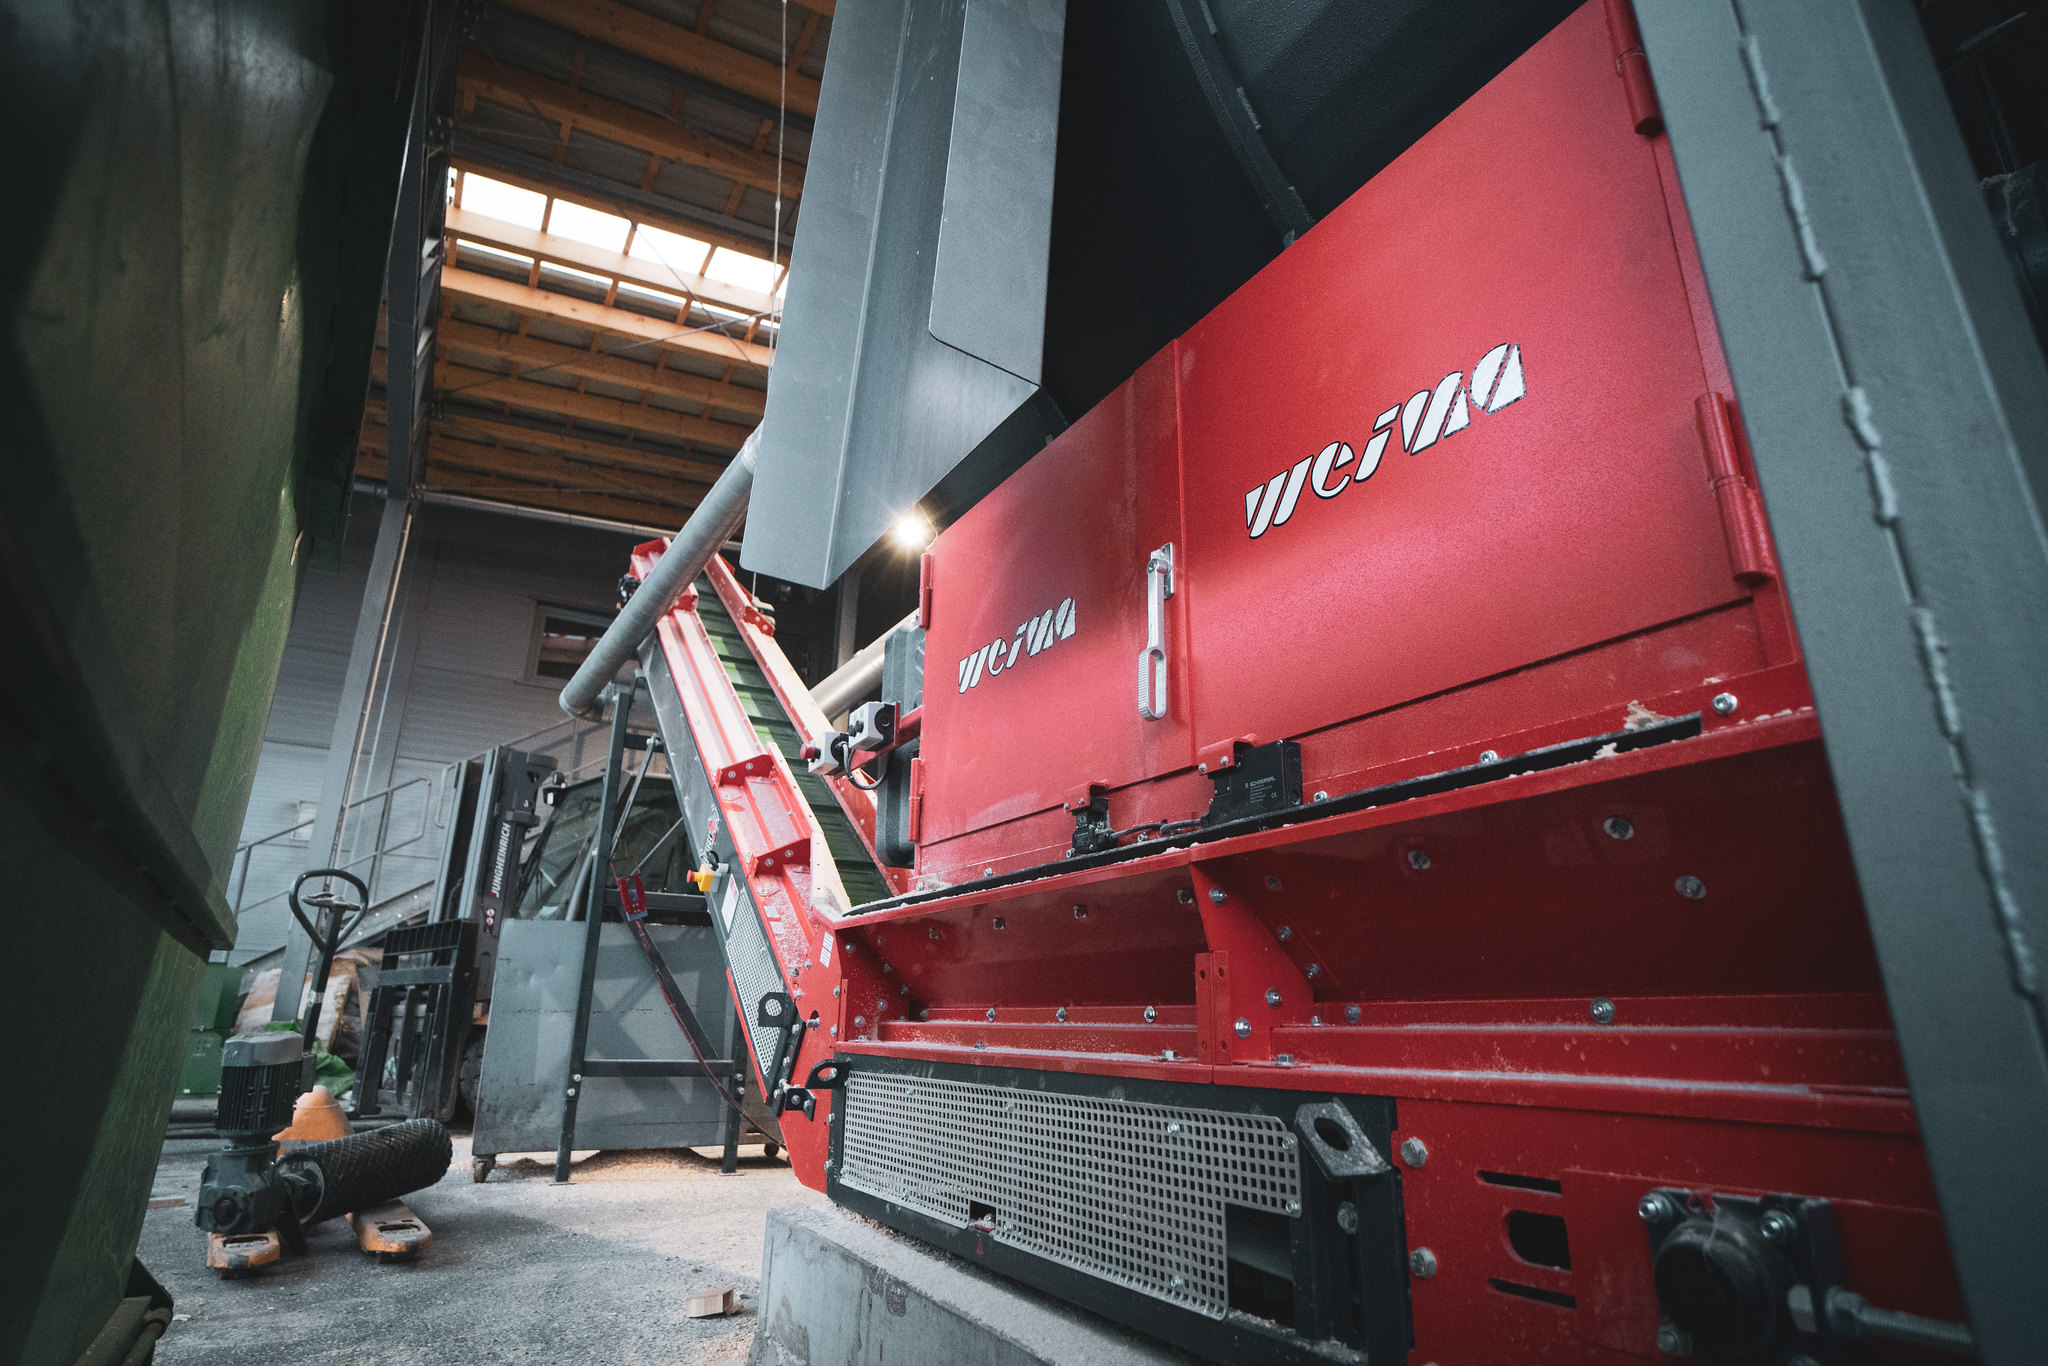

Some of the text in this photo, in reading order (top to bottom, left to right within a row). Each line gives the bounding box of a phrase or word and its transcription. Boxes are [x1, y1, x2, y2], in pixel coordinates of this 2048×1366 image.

[1244, 342, 1527, 540] weima
[958, 596, 1076, 694] weima
[491, 822, 511, 898] JUNGHEINRICH
